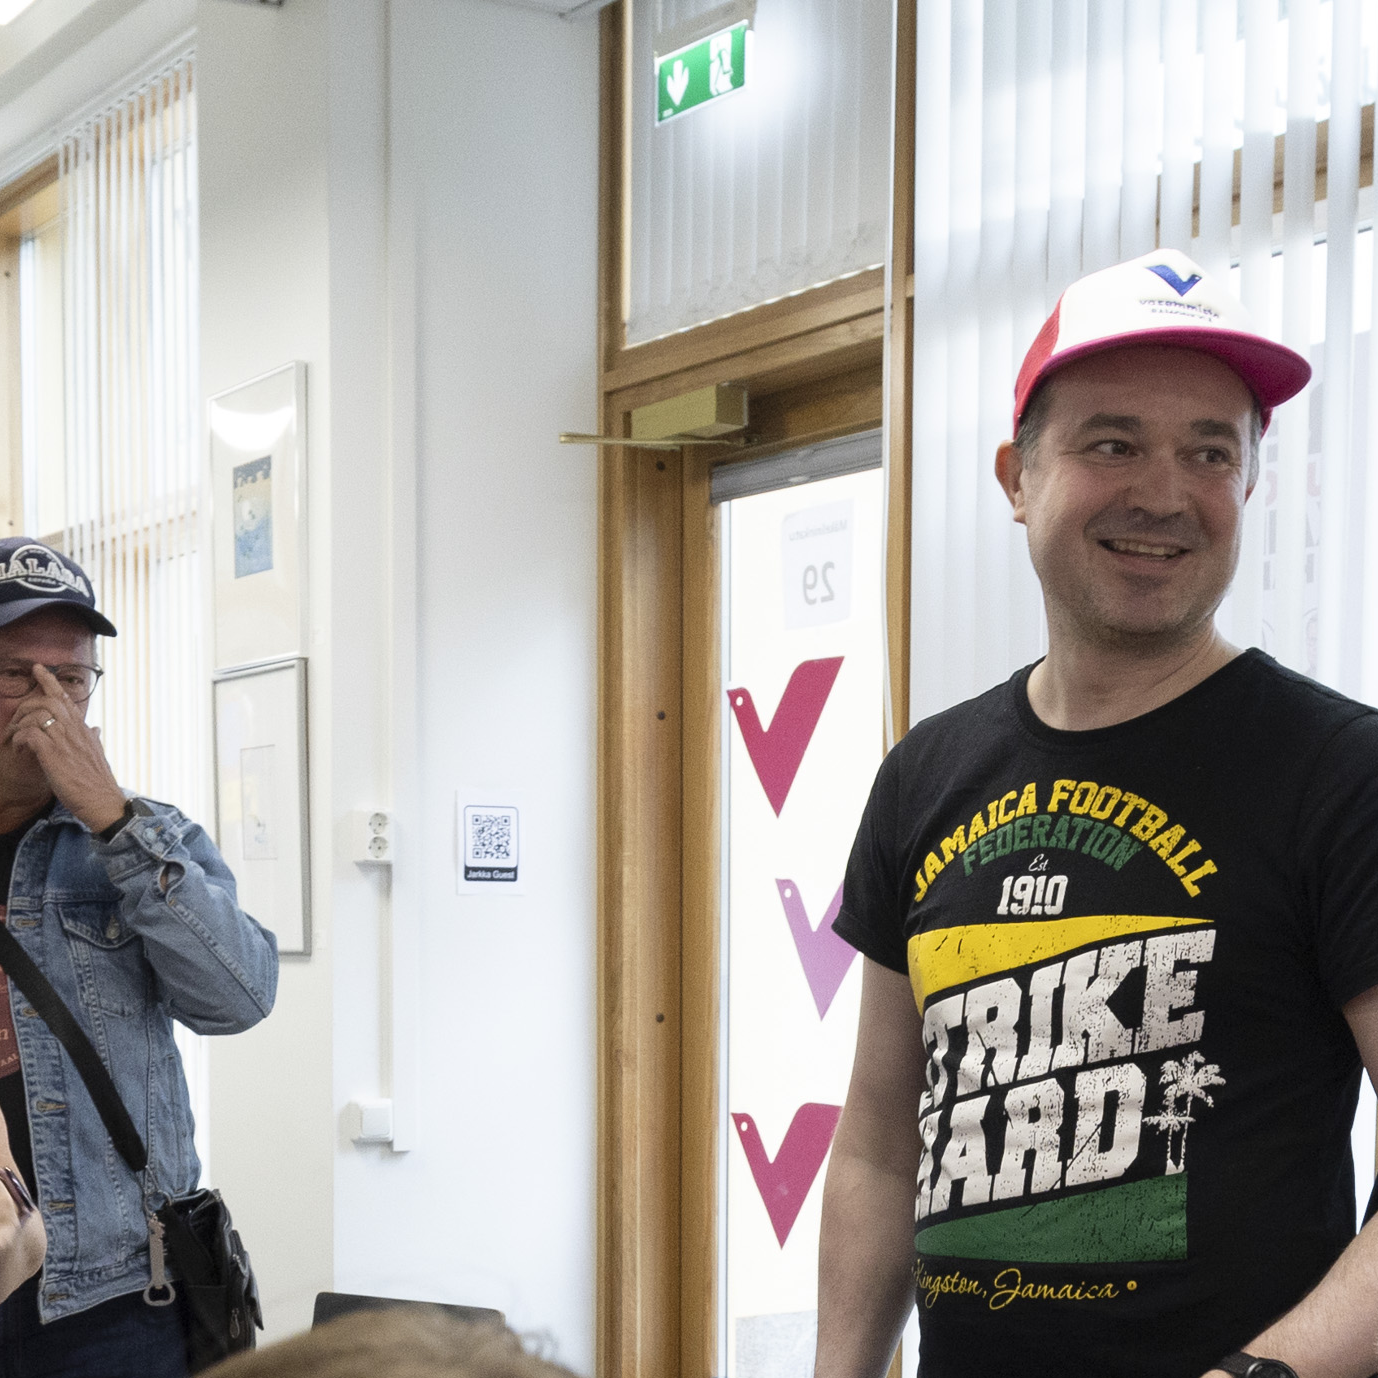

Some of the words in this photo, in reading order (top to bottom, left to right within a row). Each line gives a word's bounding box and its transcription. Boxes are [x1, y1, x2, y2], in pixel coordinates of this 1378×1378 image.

[914, 782, 1037, 902] JAMAICA
[1047, 779, 1218, 898] FOOTBALL
[962, 814, 1144, 877] FEDERATION
[996, 875, 1068, 915] 1910
[989, 1268, 1120, 1310] Jamaica
